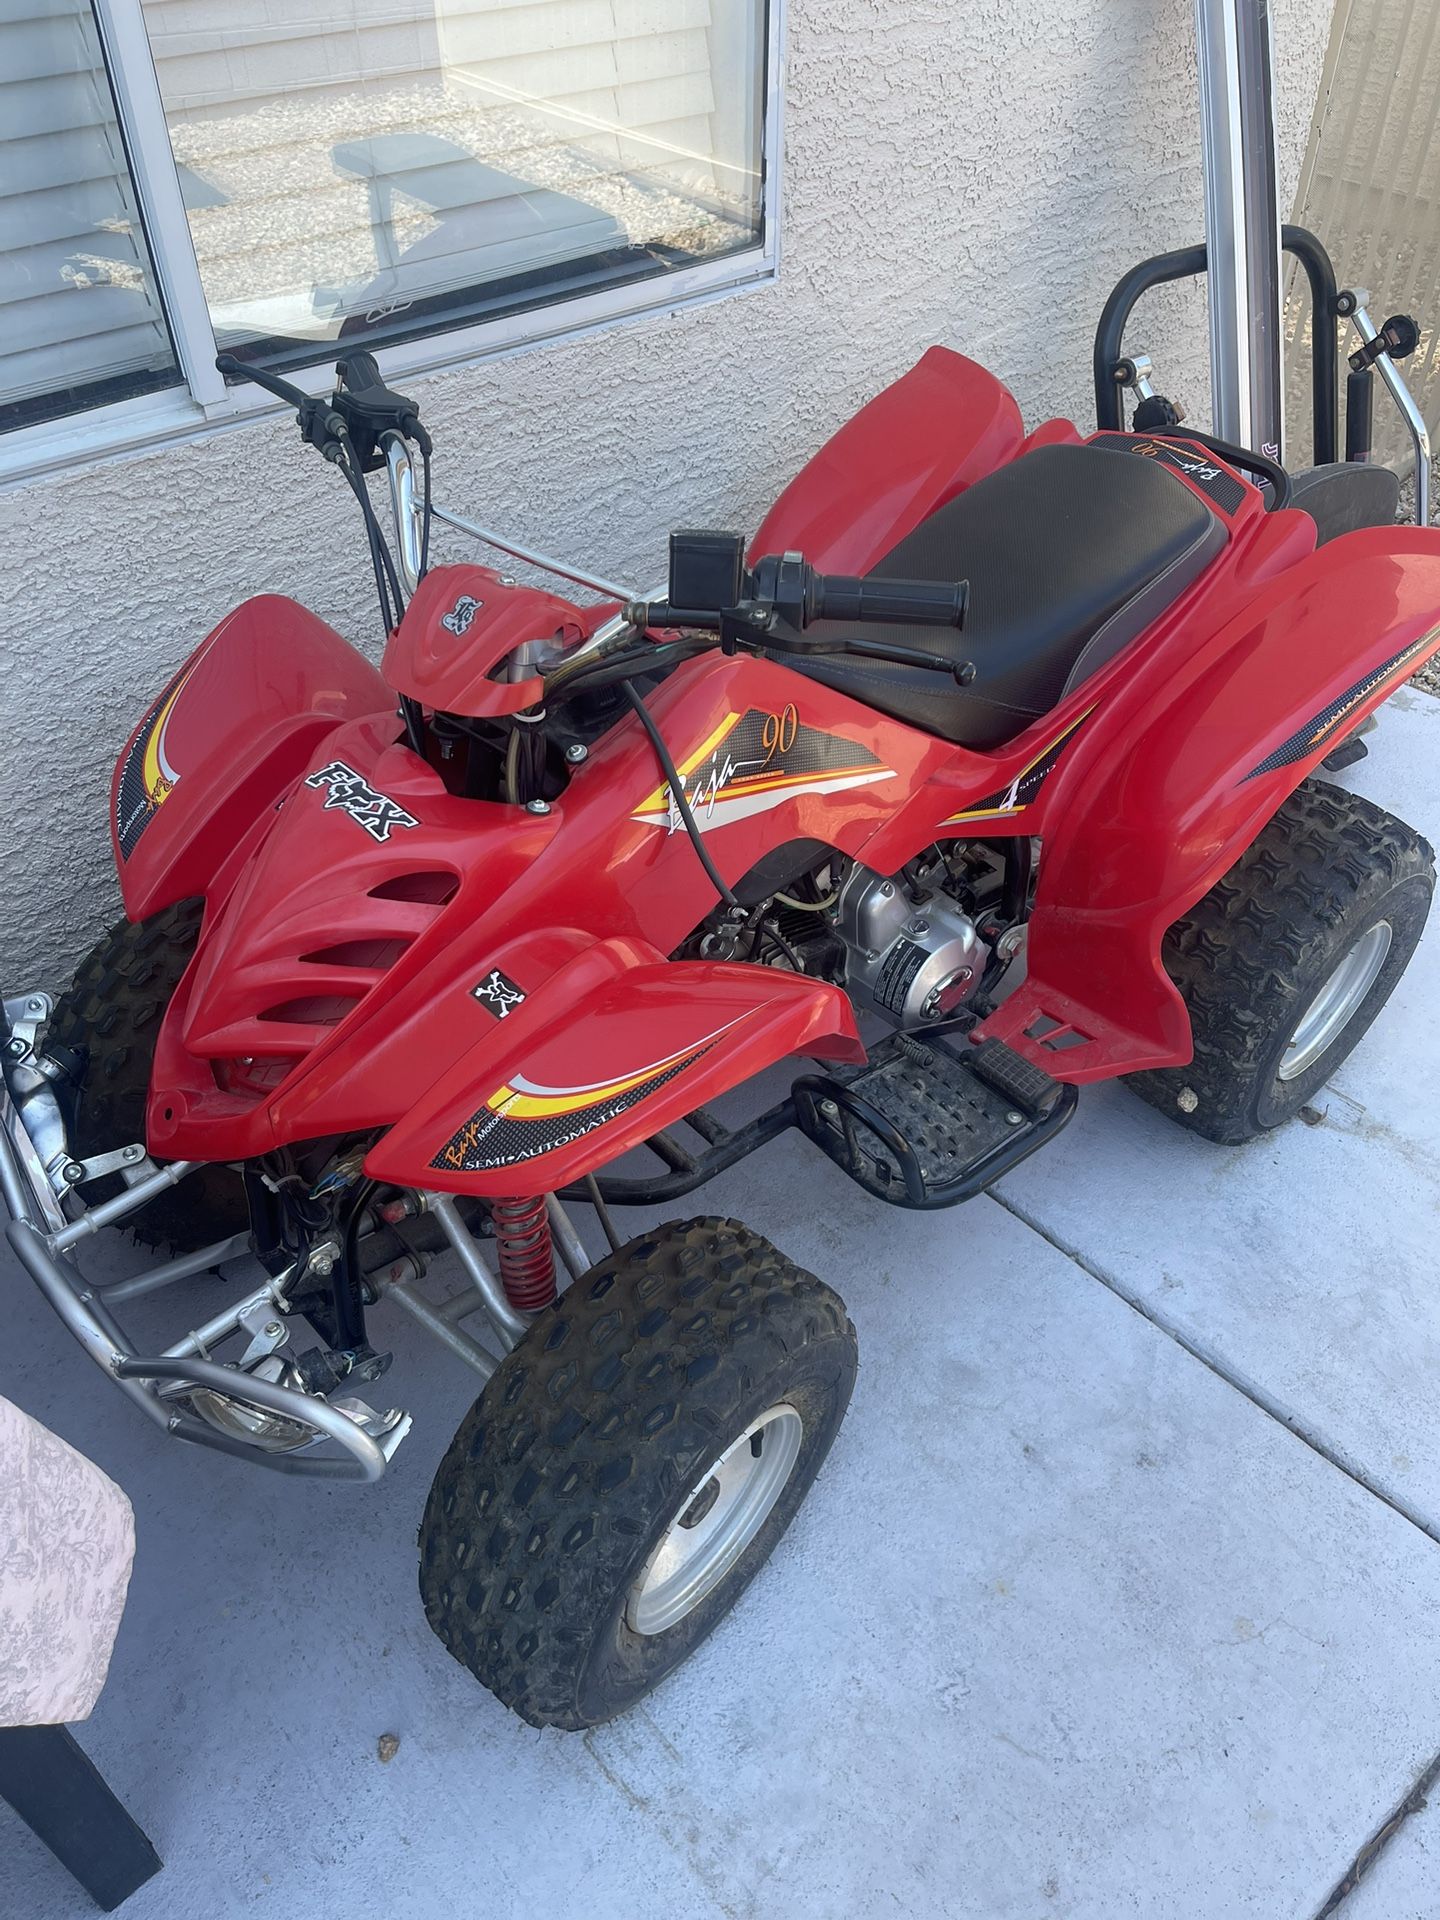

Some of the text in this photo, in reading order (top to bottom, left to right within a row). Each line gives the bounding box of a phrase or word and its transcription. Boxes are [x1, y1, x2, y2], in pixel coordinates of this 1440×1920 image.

[1167, 451, 1222, 481] Baja
[761, 702, 798, 768] 90
[999, 764, 1056, 811] 4 SPEED
[118, 799, 147, 843] Motorsports
